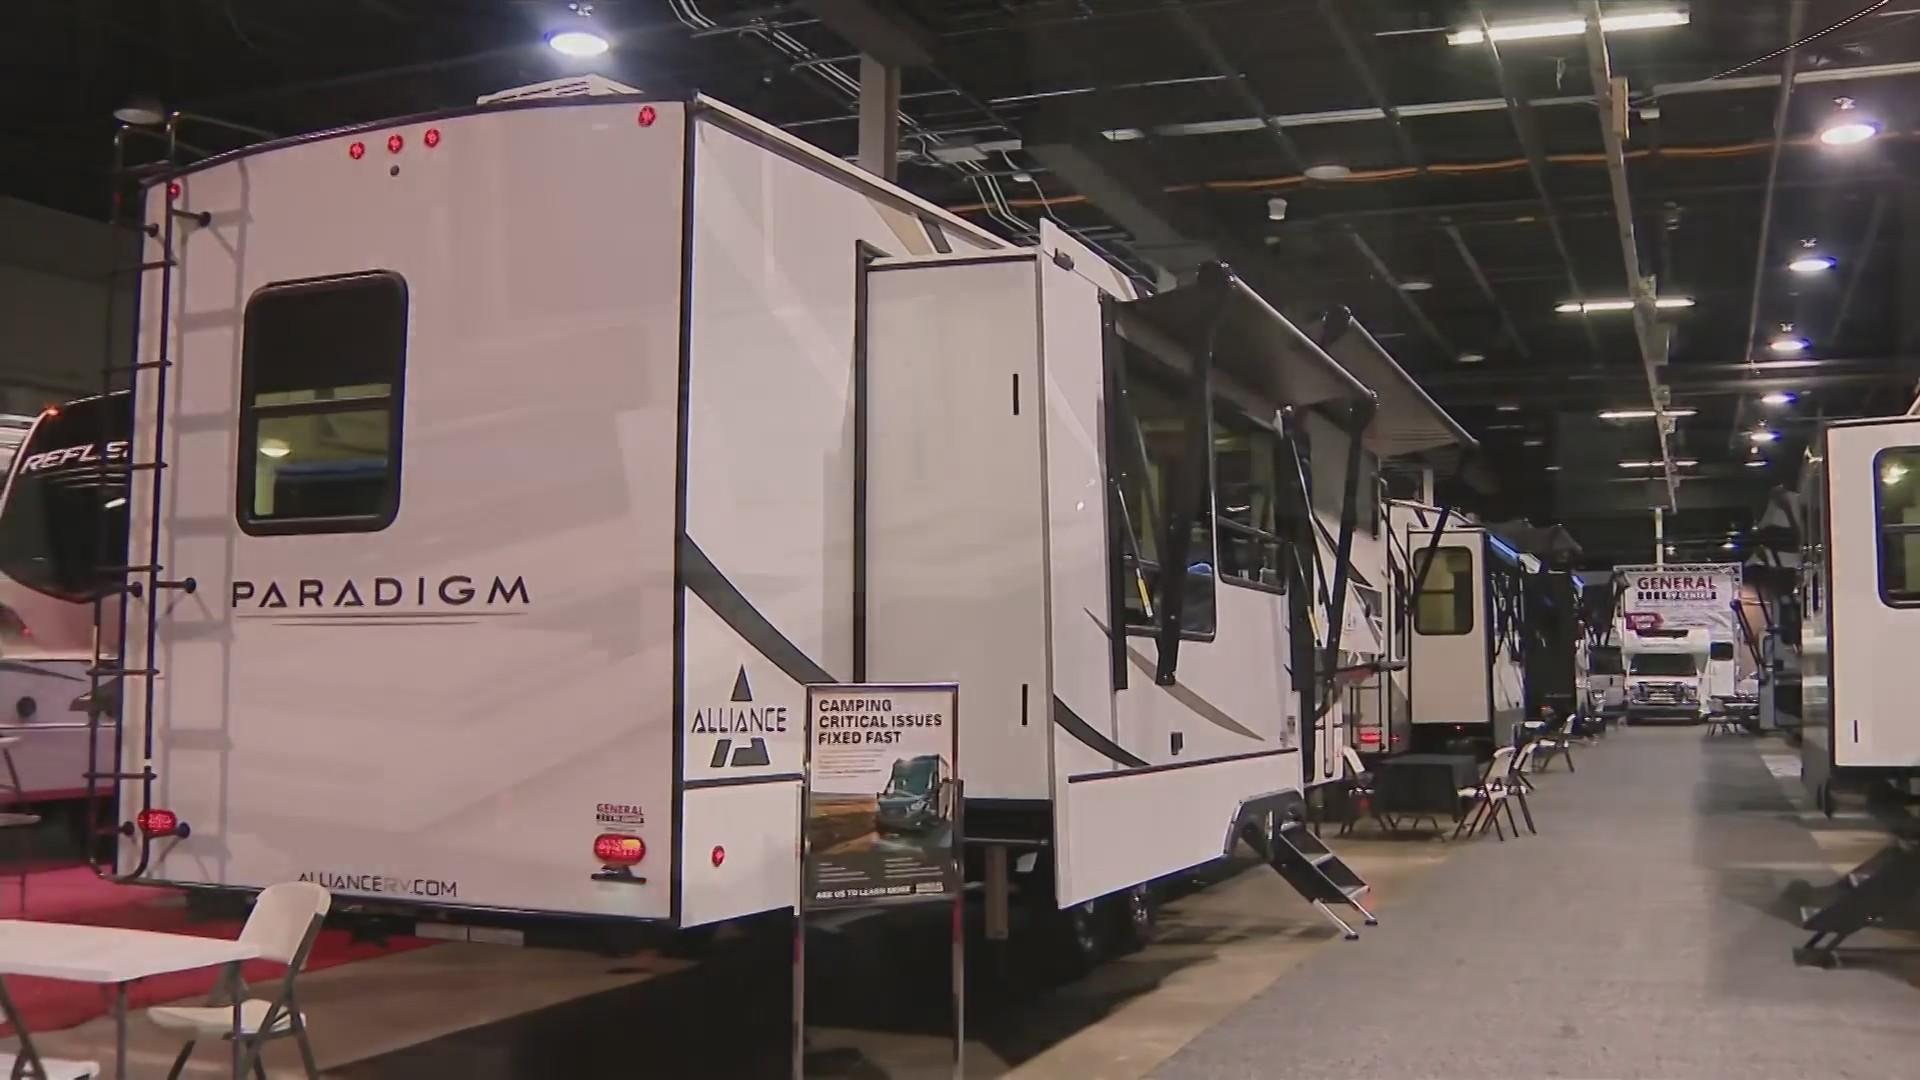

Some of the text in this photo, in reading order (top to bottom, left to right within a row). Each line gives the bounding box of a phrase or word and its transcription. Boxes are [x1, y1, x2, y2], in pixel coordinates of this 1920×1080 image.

[1638, 576, 1717, 589] GENERAL
[232, 575, 530, 608] PARADIGM
[819, 699, 892, 712] CAMPING
[691, 707, 787, 733] ALLIANCE
[819, 714, 943, 728] CRITICAL ISSUES
[818, 731, 902, 744] FIXED FAST
